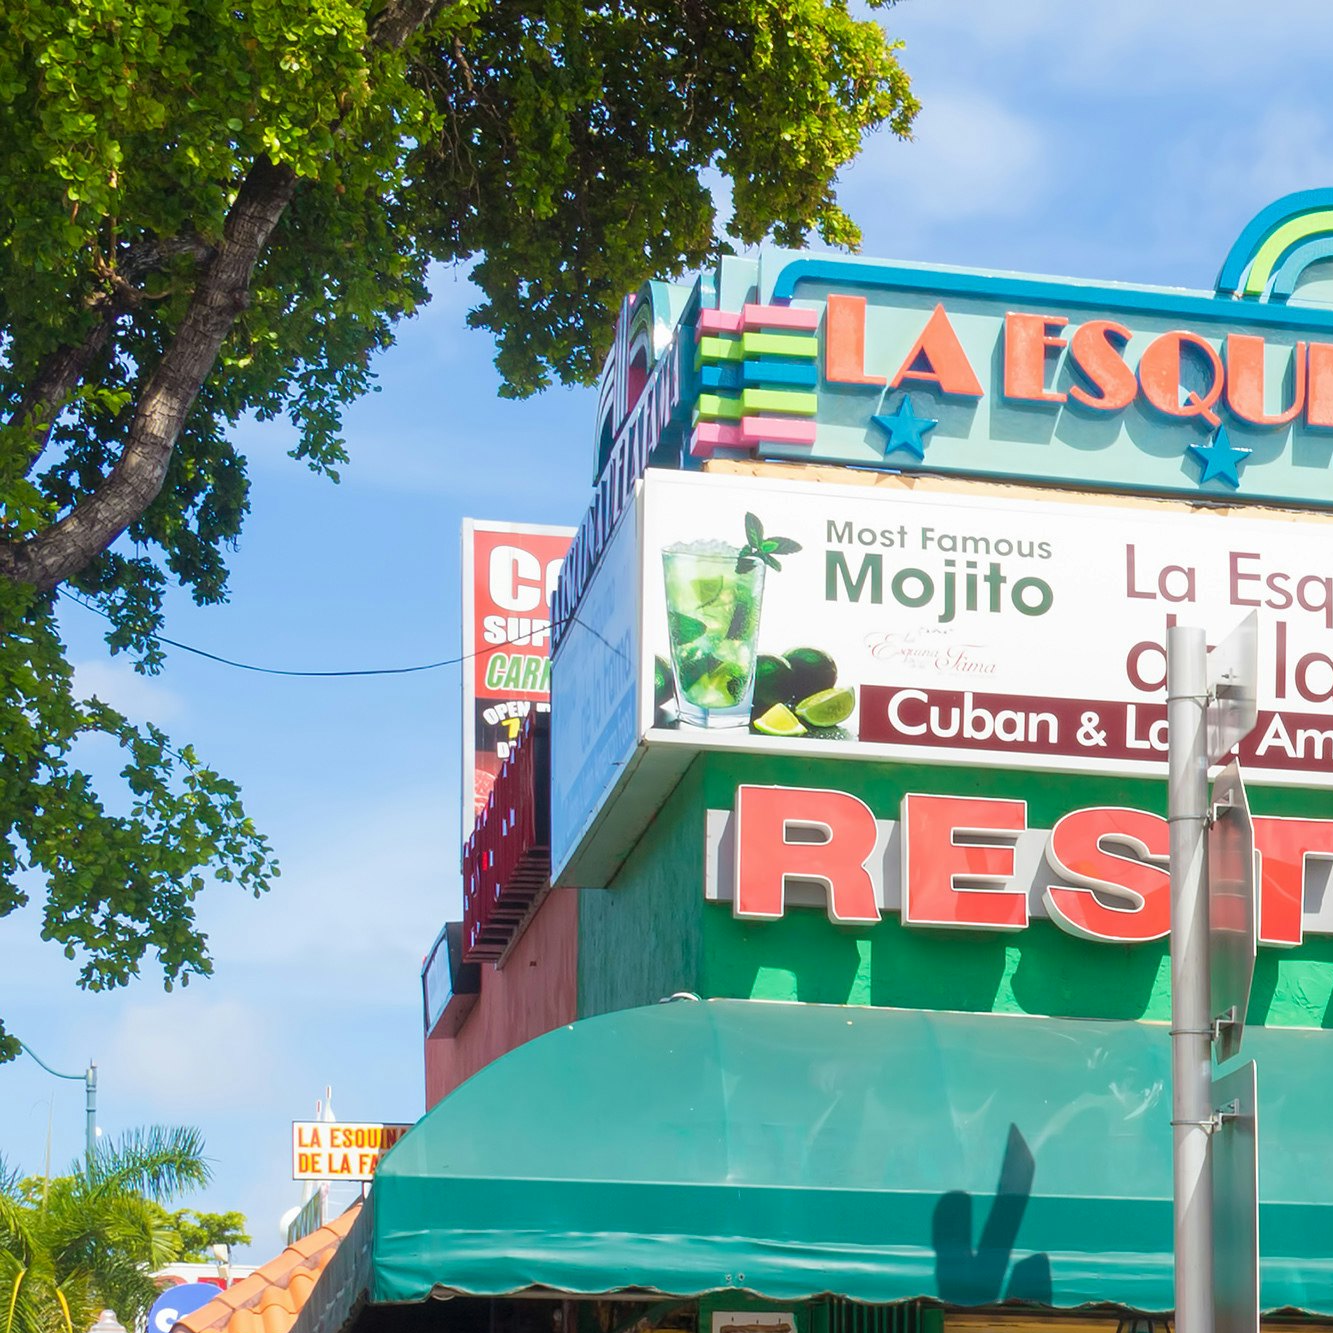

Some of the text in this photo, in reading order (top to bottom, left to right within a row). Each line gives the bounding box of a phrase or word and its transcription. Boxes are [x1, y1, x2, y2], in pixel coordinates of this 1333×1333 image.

[827, 295, 984, 399] LA
[827, 520, 1053, 560] Most Famous
[825, 550, 1054, 623] Mojito
[1126, 543, 1196, 602] La
[483, 701, 531, 725] OPEN
[502, 717, 521, 739] 7
[887, 690, 1059, 743] Cuban
[1076, 711, 1107, 747] &
[298, 1127, 322, 1148] LA
[299, 1153, 380, 1174] DE LA FA
